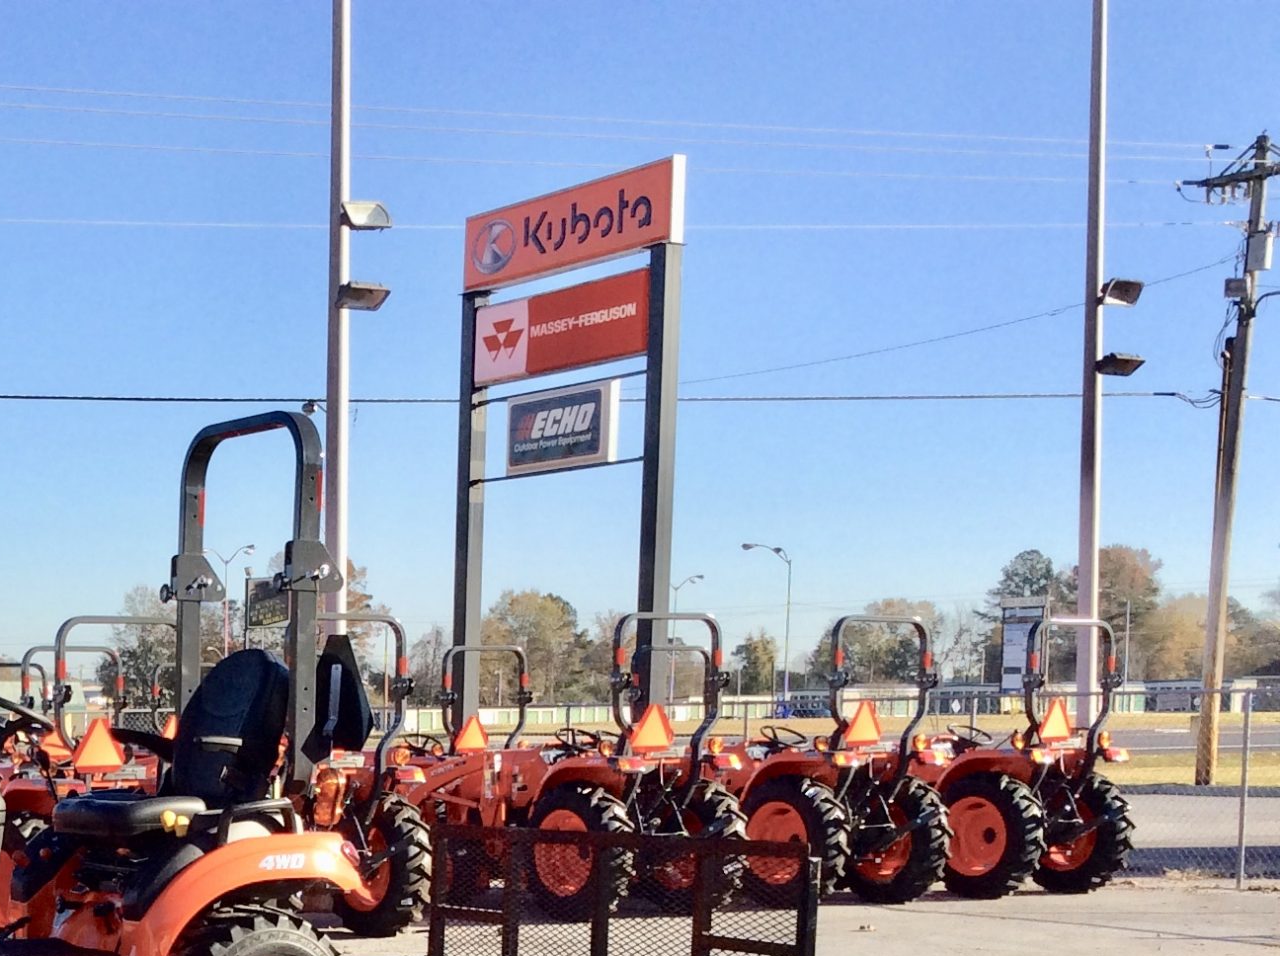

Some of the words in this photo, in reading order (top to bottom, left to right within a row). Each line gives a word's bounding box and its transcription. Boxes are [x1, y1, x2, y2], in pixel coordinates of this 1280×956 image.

[523, 188, 652, 254] Kubota
[530, 302, 637, 338] MASSEY-FERGUSON
[531, 402, 596, 439] ECHO
[514, 441, 539, 453] Outdoor
[539, 438, 558, 449] Power
[258, 853, 305, 870] 4WD
